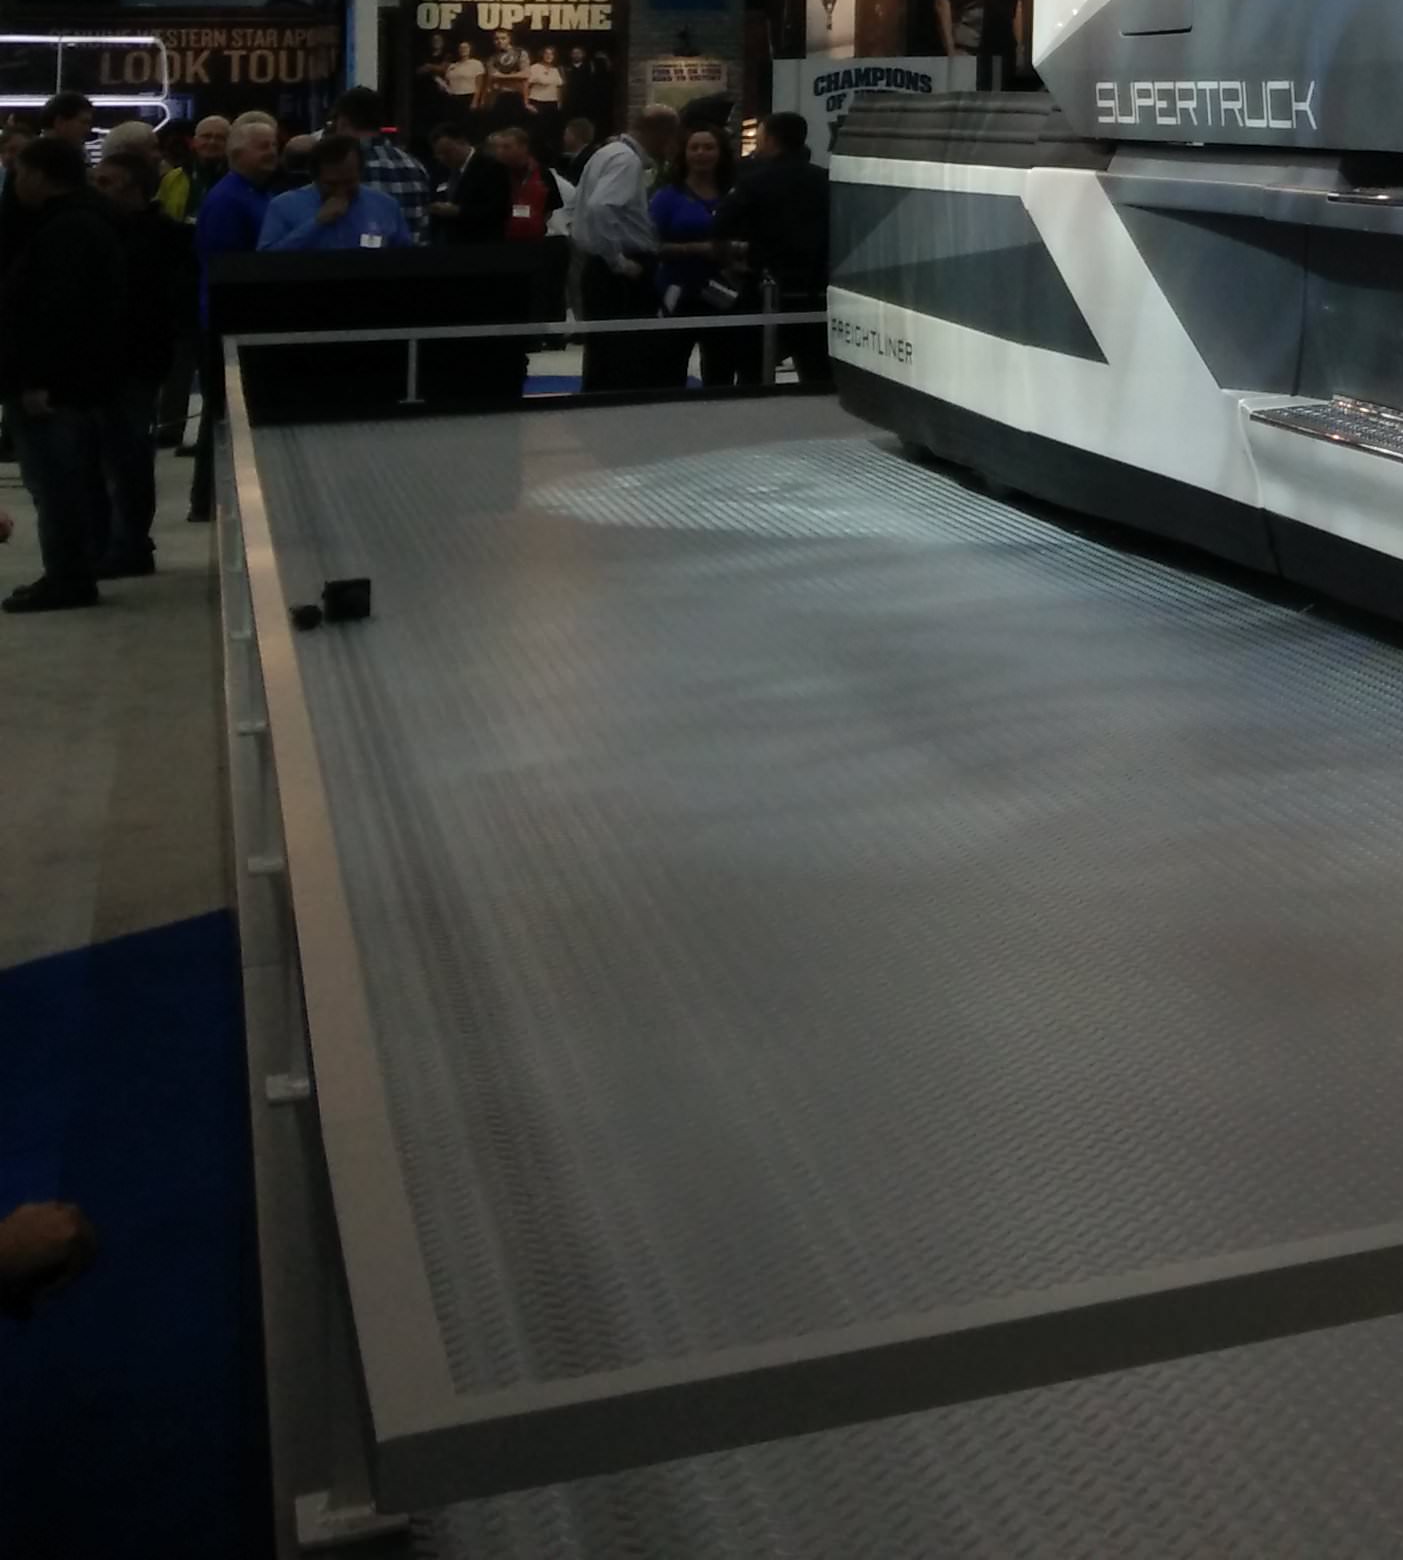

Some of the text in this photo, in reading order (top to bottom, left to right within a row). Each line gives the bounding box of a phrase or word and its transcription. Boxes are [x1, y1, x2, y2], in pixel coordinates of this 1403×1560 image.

[417, 3, 612, 30] OF UPTIME
[231, 29, 278, 48] STAR
[99, 50, 210, 85] LOOK
[815, 67, 933, 96] CHAMPIONS
[826, 93, 847, 111] OF
[1096, 81, 1318, 130] SUPERTRUCK
